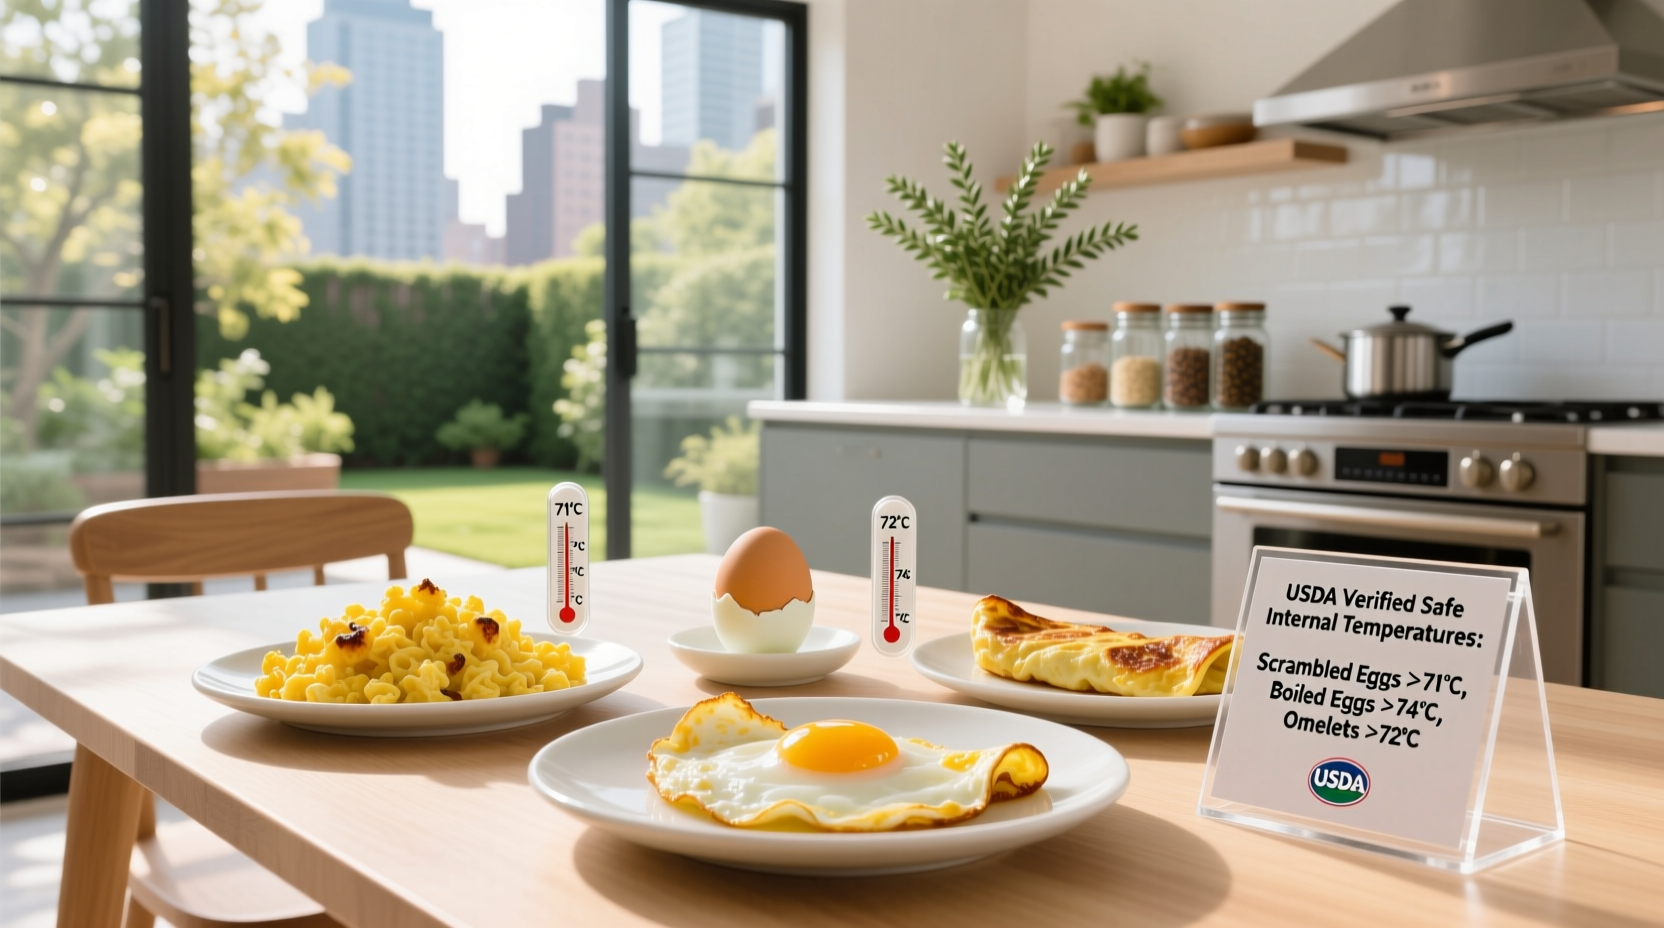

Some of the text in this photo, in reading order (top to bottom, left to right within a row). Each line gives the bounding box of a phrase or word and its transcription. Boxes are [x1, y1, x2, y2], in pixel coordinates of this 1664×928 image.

[1286, 583, 1464, 618] USDA Verified Safe
[1266, 608, 1483, 648] Internal Temperatures:
[1257, 652, 1353, 681] Scrambled
[1356, 665, 1401, 690] Eggs
[1270, 681, 1326, 705] Boiled
[1330, 690, 1375, 716] Eggs
[1283, 711, 1359, 739] Omelets
[1314, 768, 1365, 794] USDA
